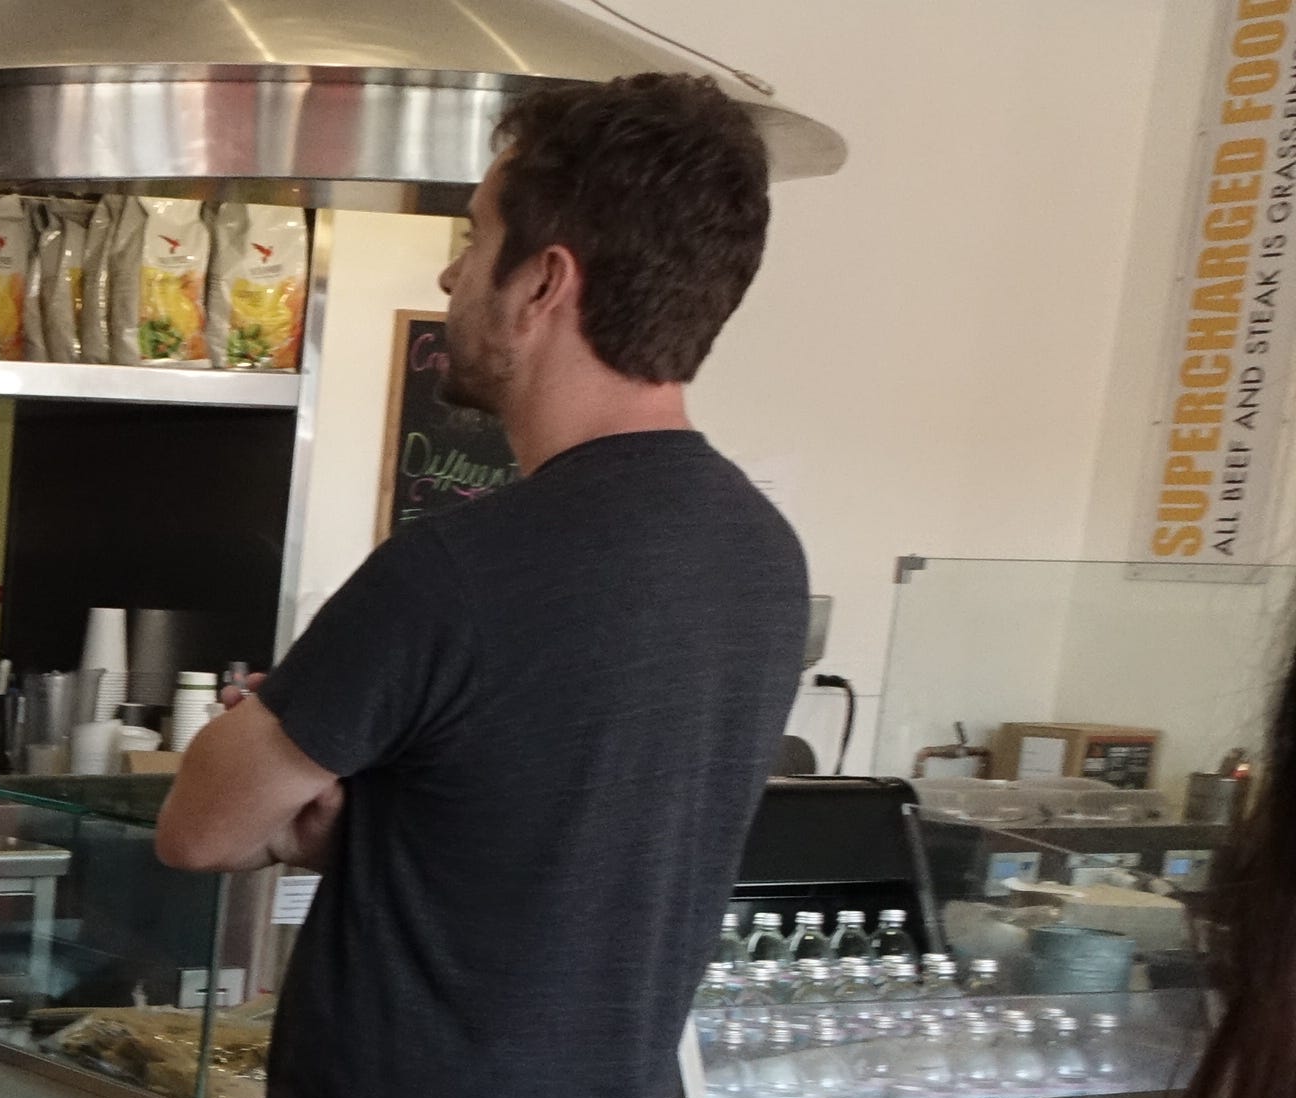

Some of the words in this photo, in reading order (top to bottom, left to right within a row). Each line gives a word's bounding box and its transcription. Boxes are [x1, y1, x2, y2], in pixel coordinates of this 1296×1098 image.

[1260, 233, 1287, 258] IS
[1246, 269, 1281, 355] STEAK
[1151, 137, 1267, 557] SUPERCHARGED
[1233, 366, 1266, 431] AND
[1221, 440, 1252, 502] BEEF
[1211, 511, 1240, 557] ALL
